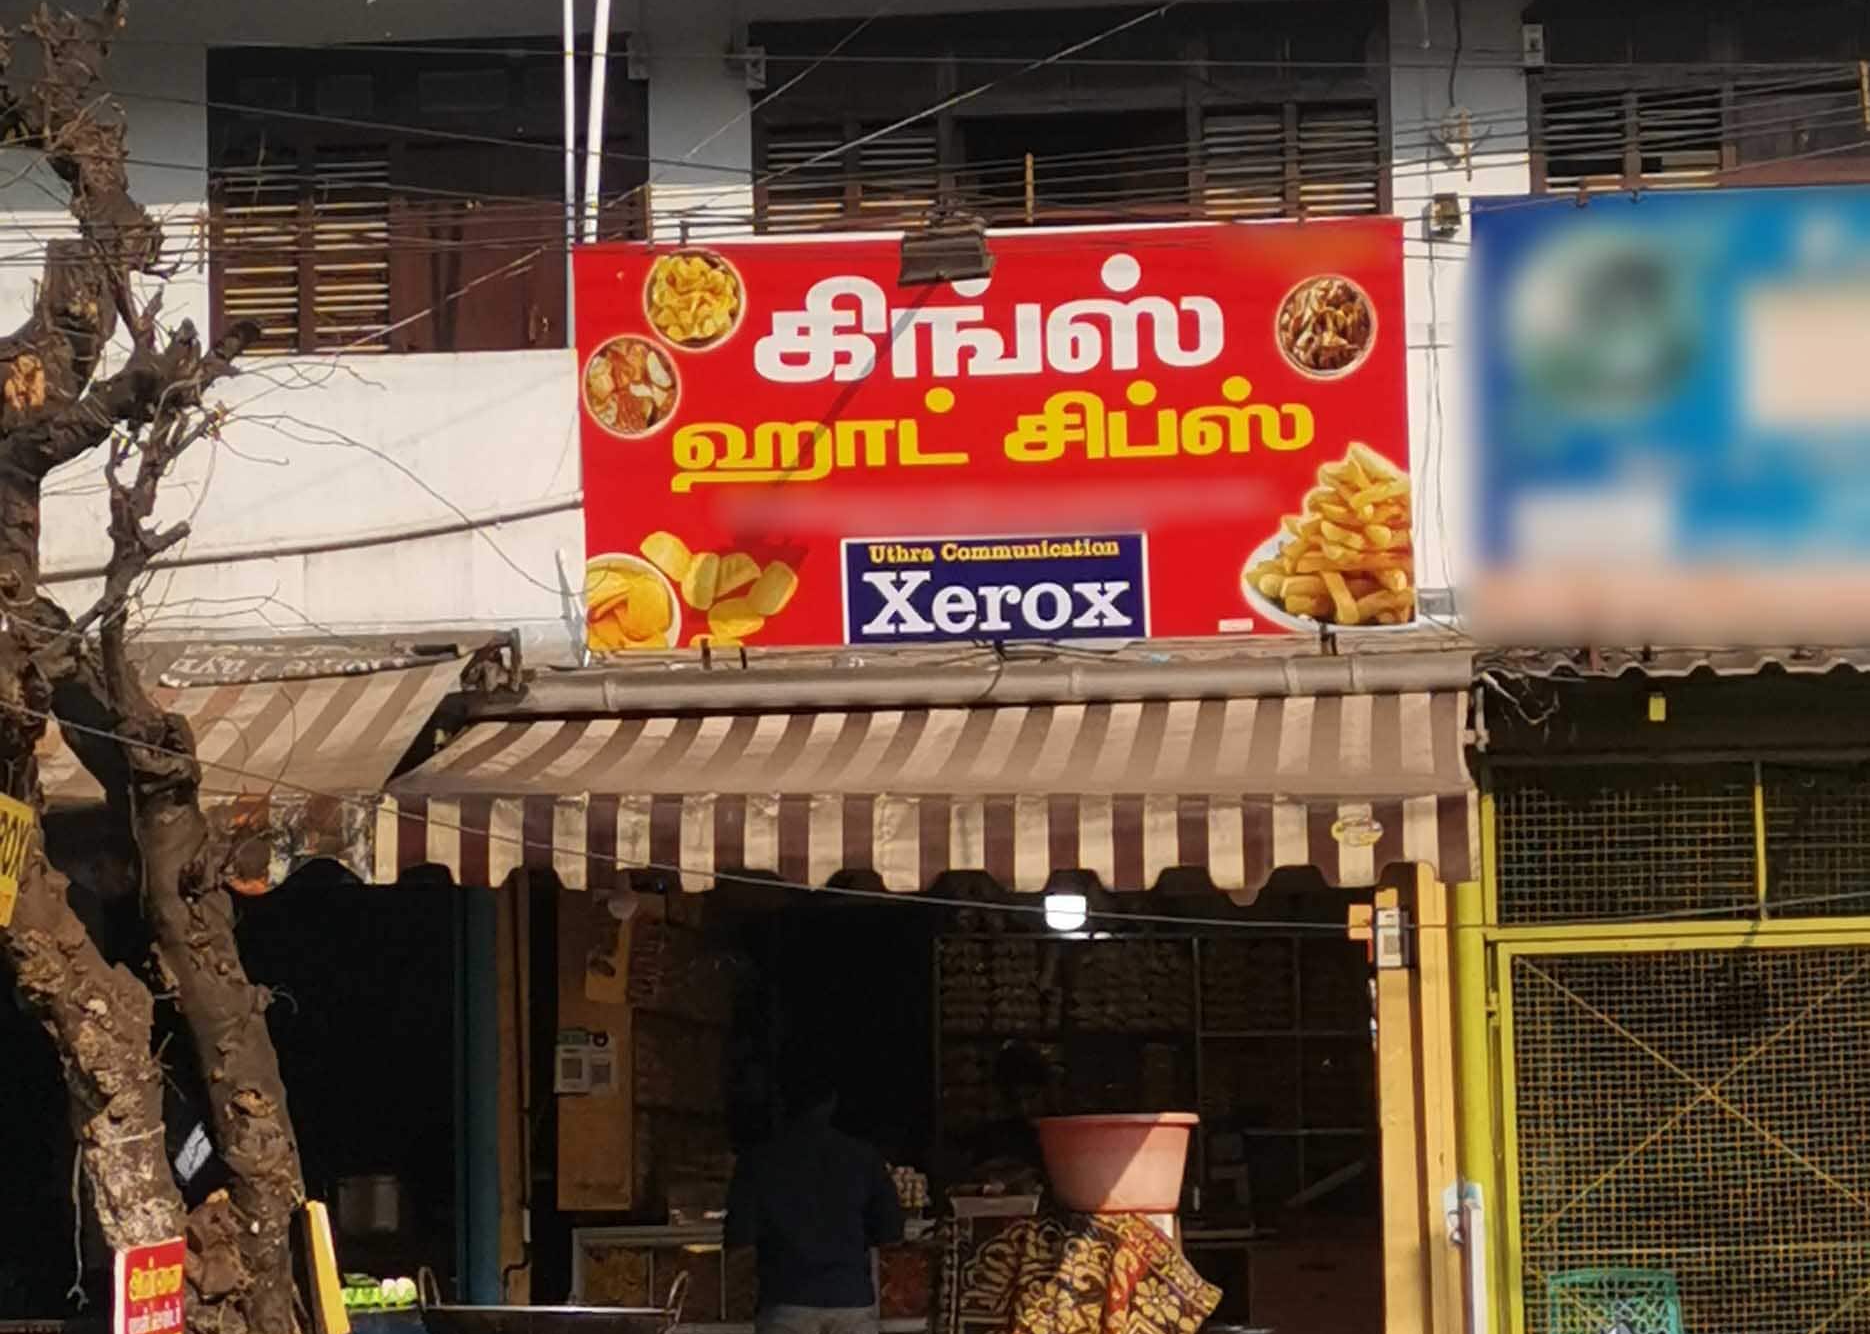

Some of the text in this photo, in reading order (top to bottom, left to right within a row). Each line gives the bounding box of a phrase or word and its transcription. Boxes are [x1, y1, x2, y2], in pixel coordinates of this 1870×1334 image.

[753, 253, 1225, 383] கிங்ஸ்
[670, 375, 1315, 493] ஹாட் சிப்ஸ்
[868, 537, 1120, 565] Uthra Communication
[861, 570, 1133, 635] Xerox
